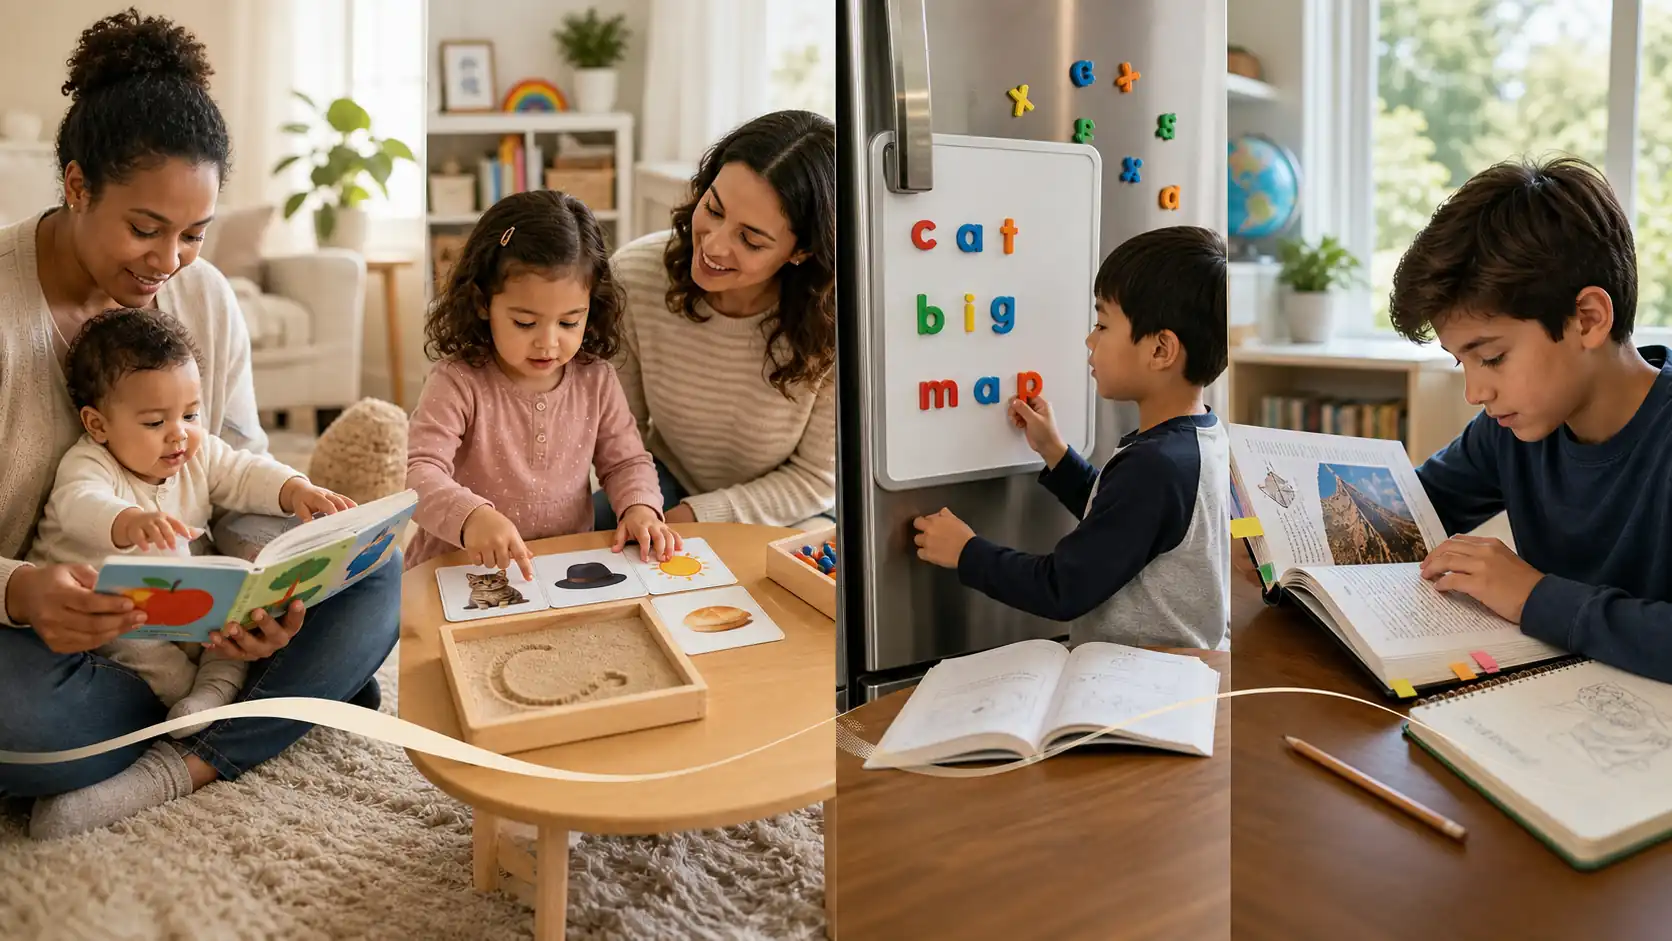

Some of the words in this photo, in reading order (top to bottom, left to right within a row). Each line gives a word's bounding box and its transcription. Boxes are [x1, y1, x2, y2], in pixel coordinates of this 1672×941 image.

[911, 218, 1019, 254] cat
[917, 294, 1015, 335] big
[919, 371, 1043, 411] map
